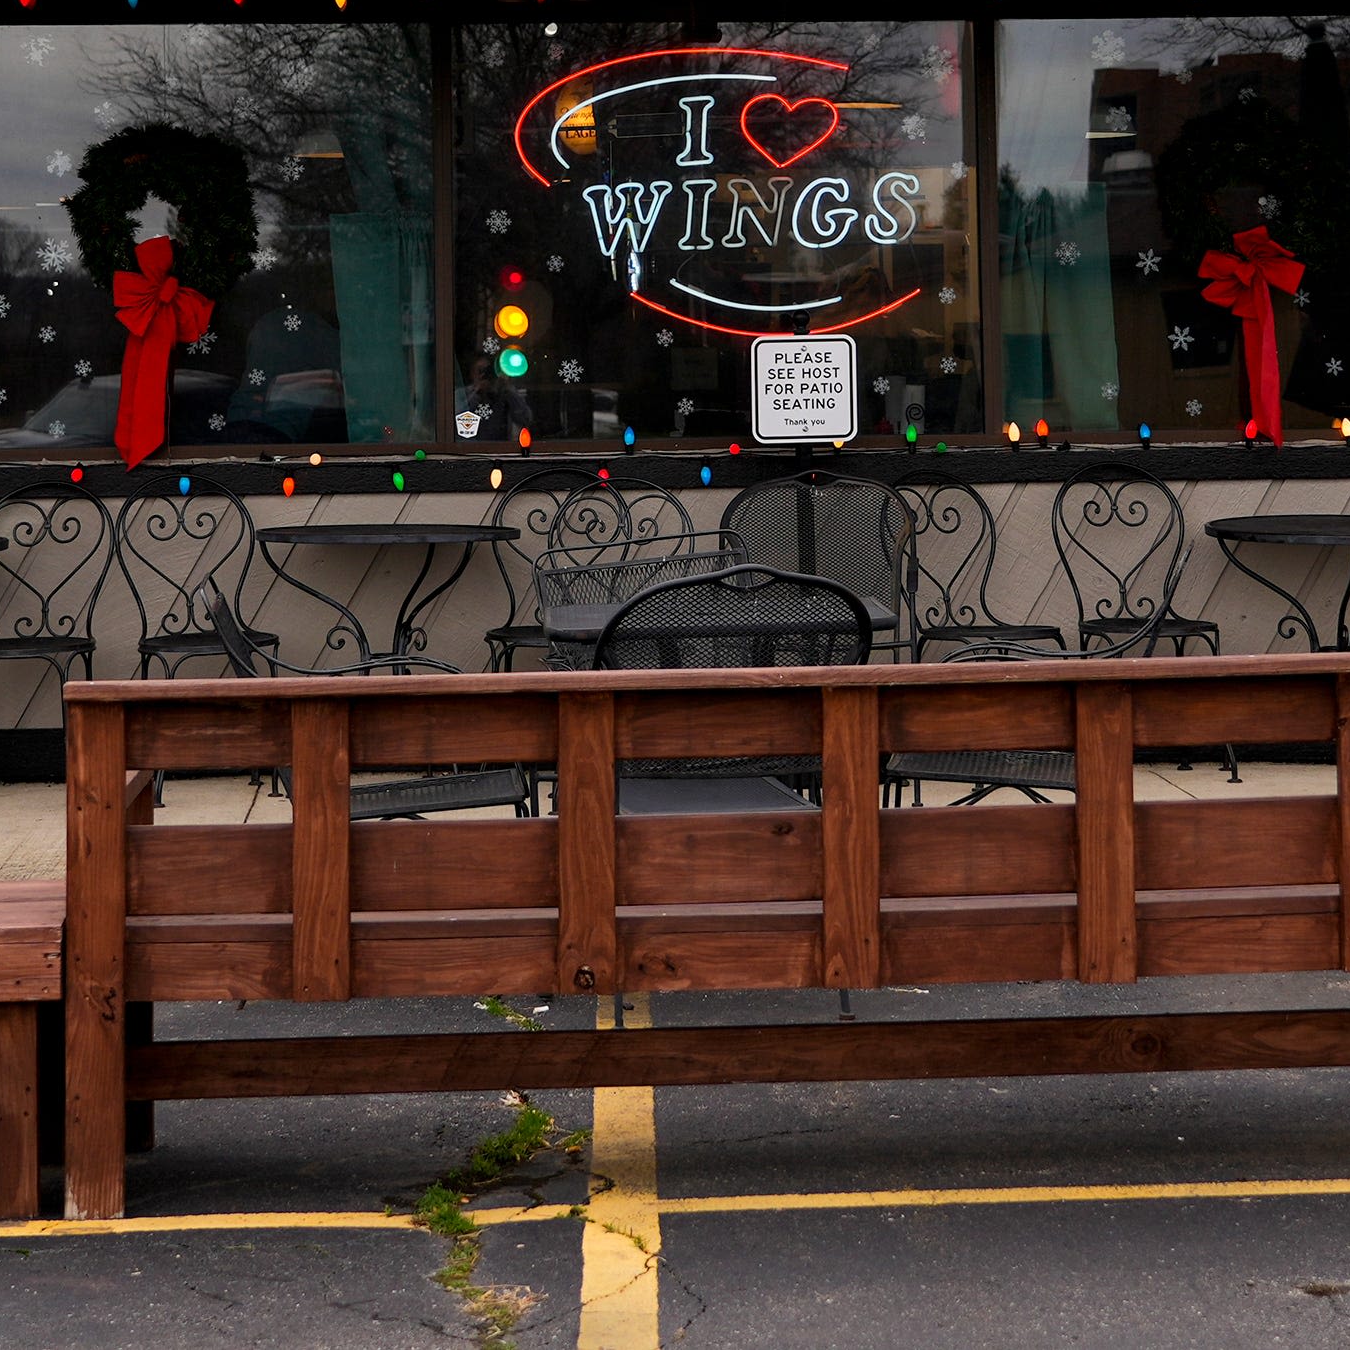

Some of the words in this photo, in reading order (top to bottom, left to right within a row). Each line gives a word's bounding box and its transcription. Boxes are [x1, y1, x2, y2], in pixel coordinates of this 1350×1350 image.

[565, 129, 597, 139] LAGE
[675, 95, 715, 166] I
[582, 171, 921, 256] WINGS
[774, 352, 833, 364] PLEASE
[767, 368, 796, 380] SEE
[802, 367, 840, 379] HOST
[764, 383, 794, 395] FOR
[800, 382, 844, 394] PATIO
[772, 398, 836, 410] SEATING
[784, 418, 809, 426] Thank
[810, 419, 826, 427] you
